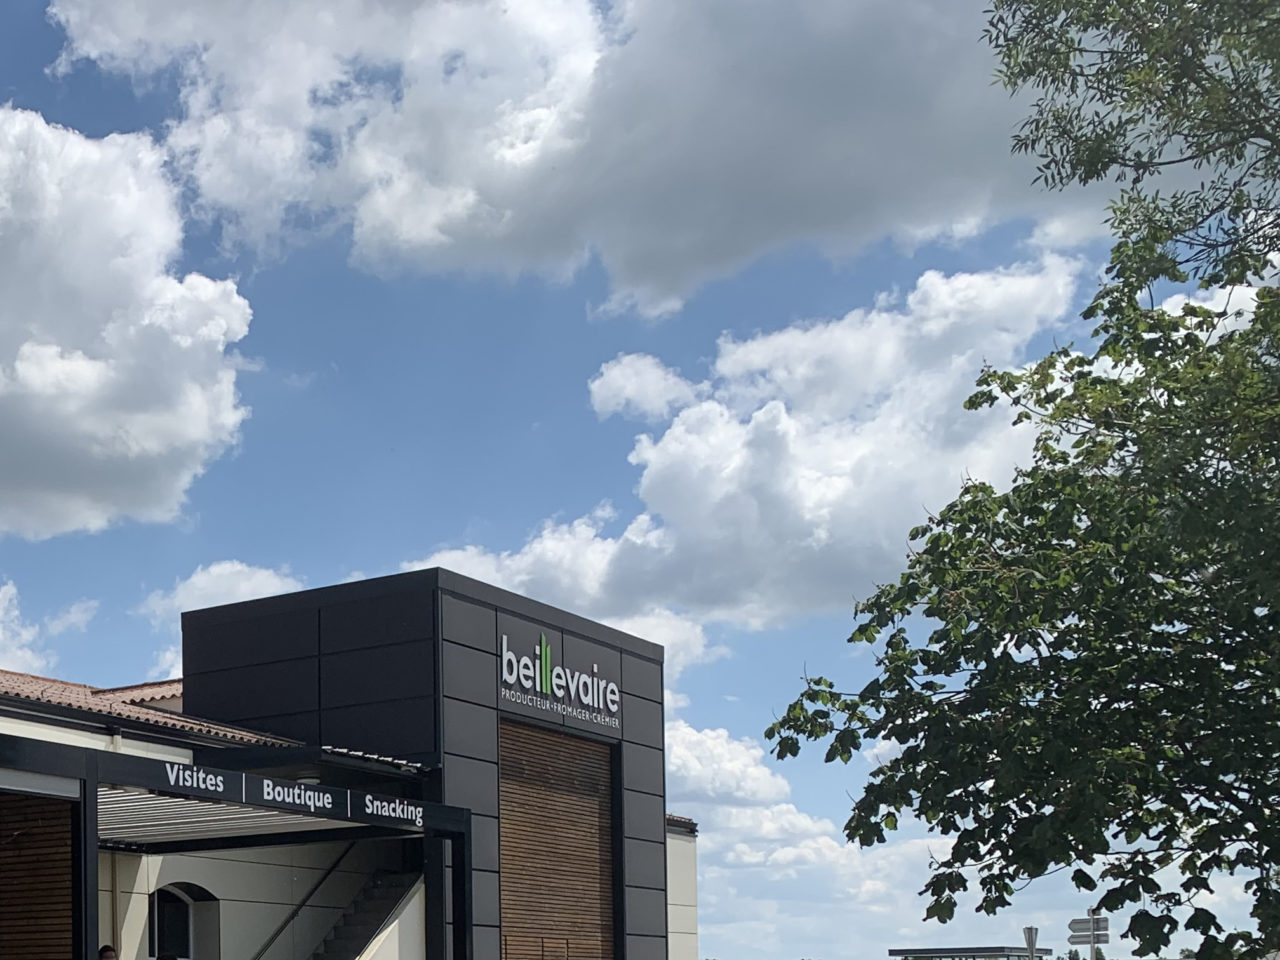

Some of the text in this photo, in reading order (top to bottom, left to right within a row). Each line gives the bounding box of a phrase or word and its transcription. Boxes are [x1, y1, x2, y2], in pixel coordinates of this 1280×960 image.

[502, 632, 619, 712] beillevaire
[501, 688, 550, 710] PRODUCTEUR
[554, 702, 590, 721] FROMAGER
[165, 763, 423, 826] Visites Boutique Snacking
